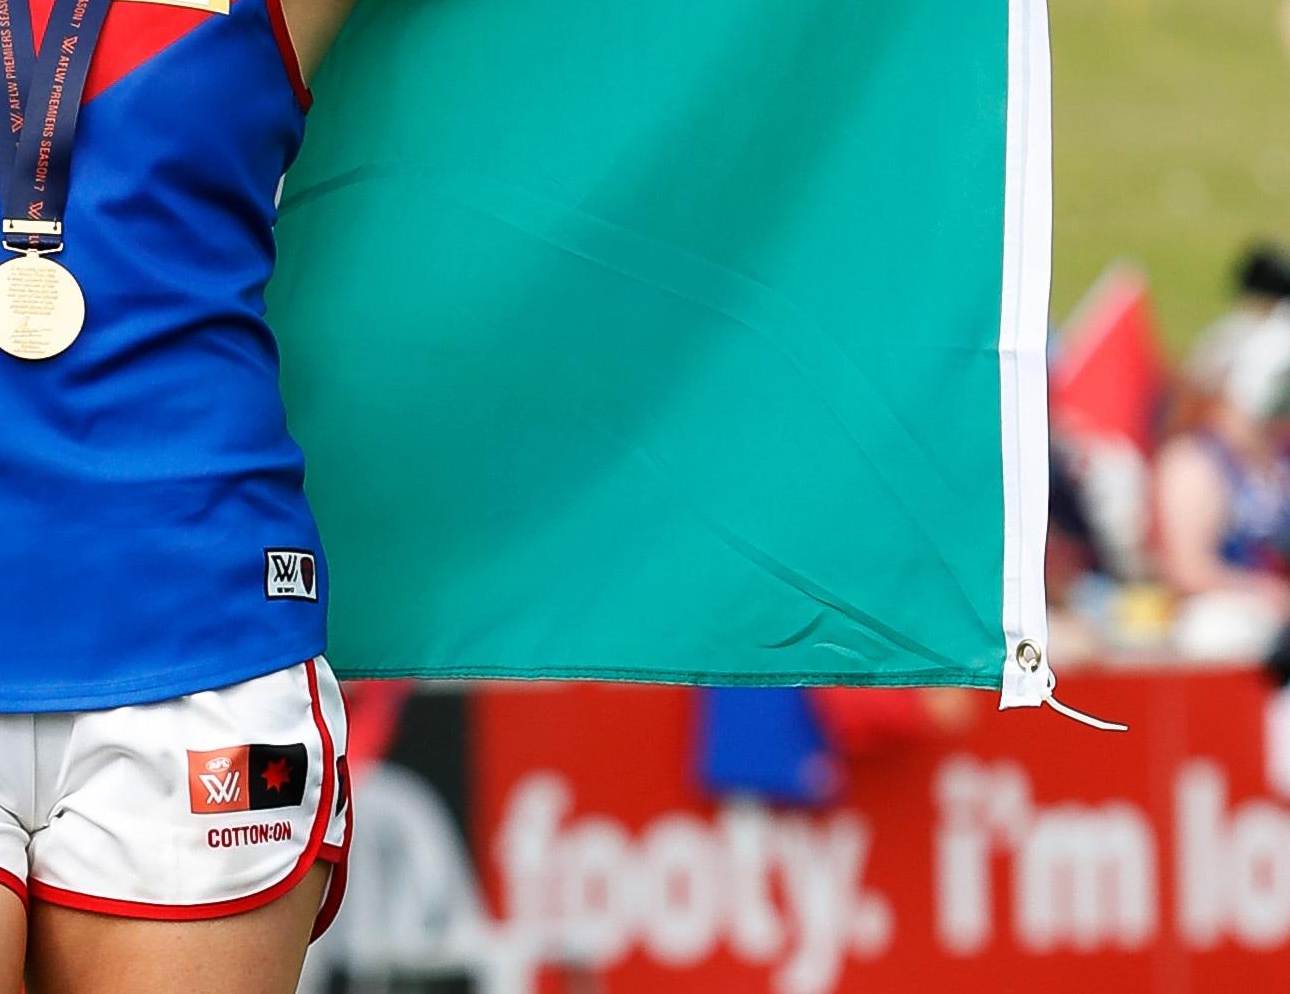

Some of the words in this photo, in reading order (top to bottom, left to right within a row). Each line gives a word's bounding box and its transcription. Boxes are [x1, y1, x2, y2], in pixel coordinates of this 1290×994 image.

[1, 29, 16, 79] PREMIERS
[54, 56, 70, 84] AFLW
[8, 82, 22, 111] AFLW
[42, 85, 64, 138] PREMIERS
[35, 139, 52, 182] SEASON
[208, 821, 292, 848] COTTON:ON
[498, 770, 894, 994] footy.
[1174, 760, 1290, 950] lo
